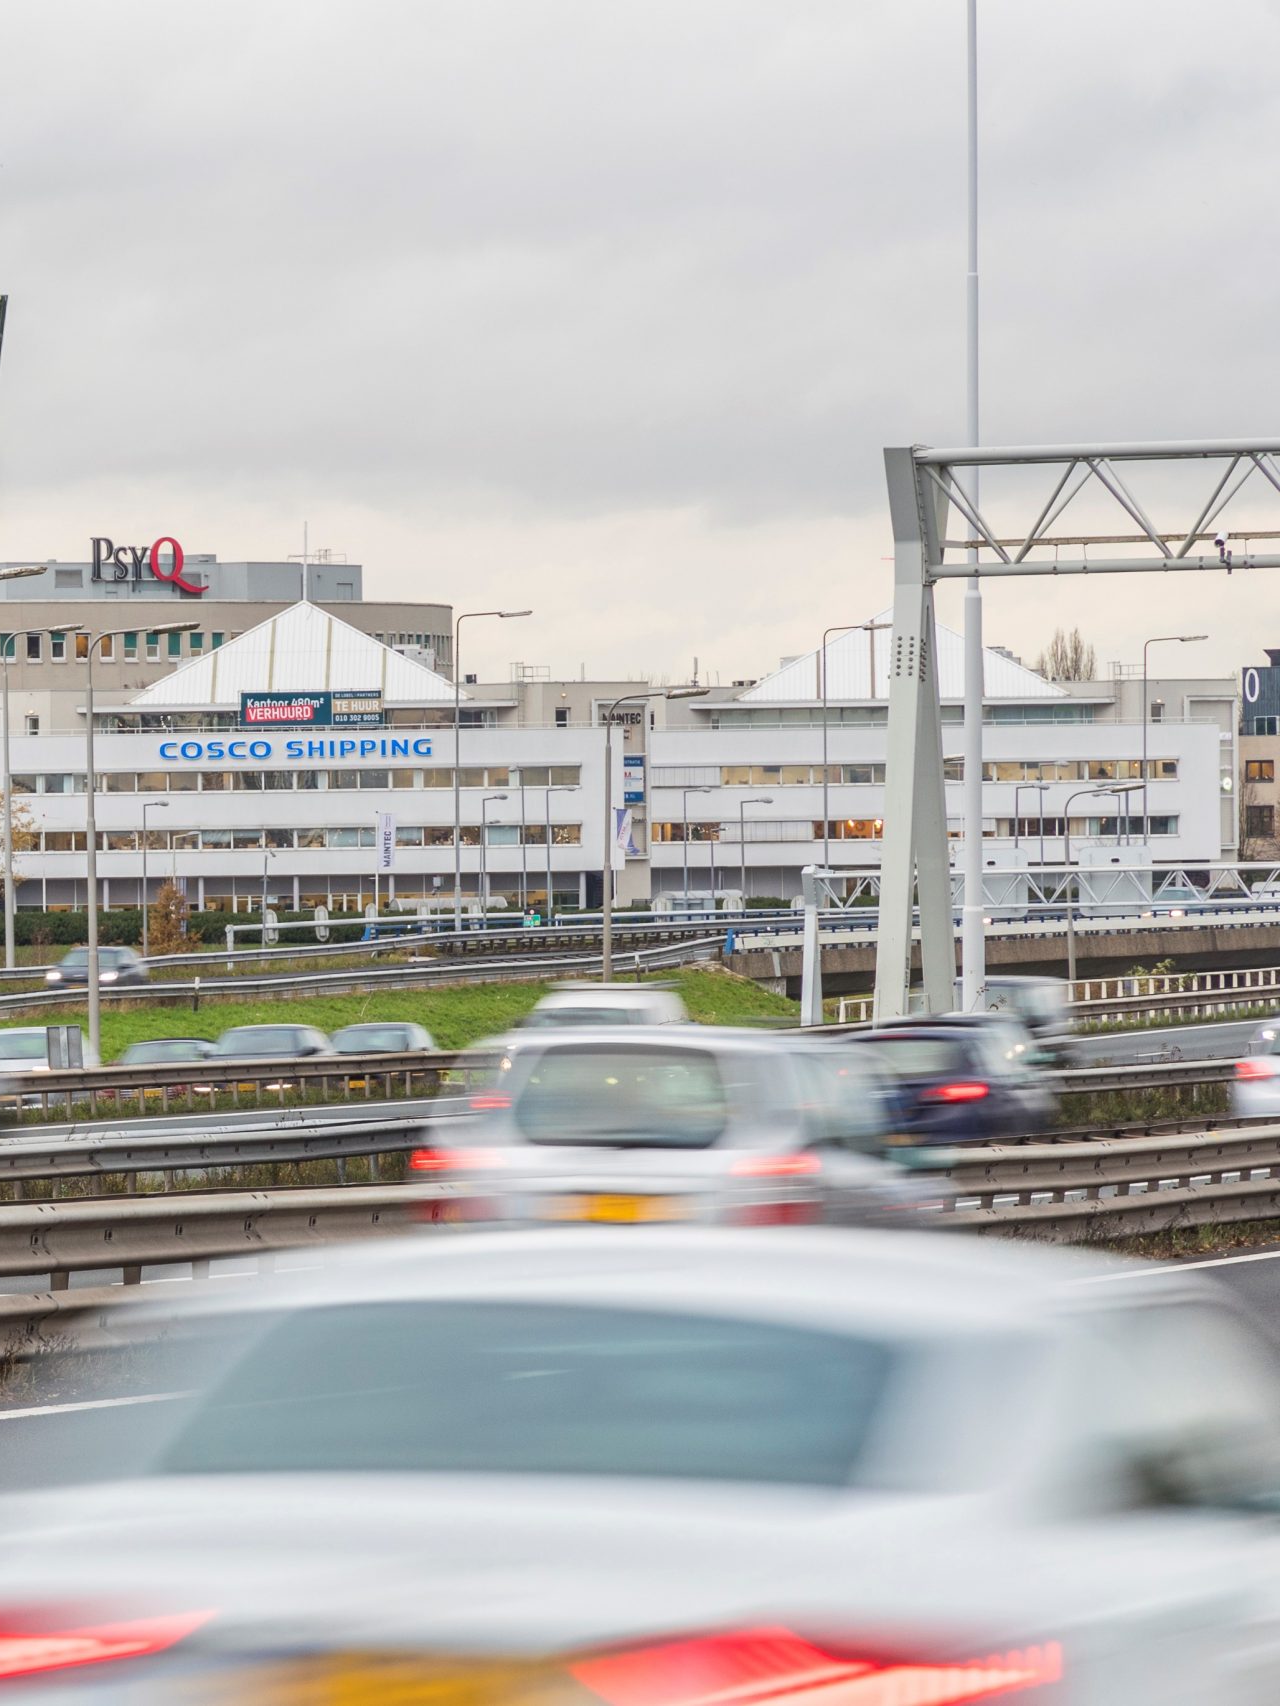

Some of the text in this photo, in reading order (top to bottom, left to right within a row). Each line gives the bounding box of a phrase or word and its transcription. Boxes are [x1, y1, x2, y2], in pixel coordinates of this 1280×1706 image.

[248, 706, 312, 721] VERHUURD
[335, 700, 380, 712] TE HUUR
[349, 714, 362, 722] 302
[159, 738, 433, 760] COSCO SHIPPING
[383, 830, 392, 868] MAINTEC
